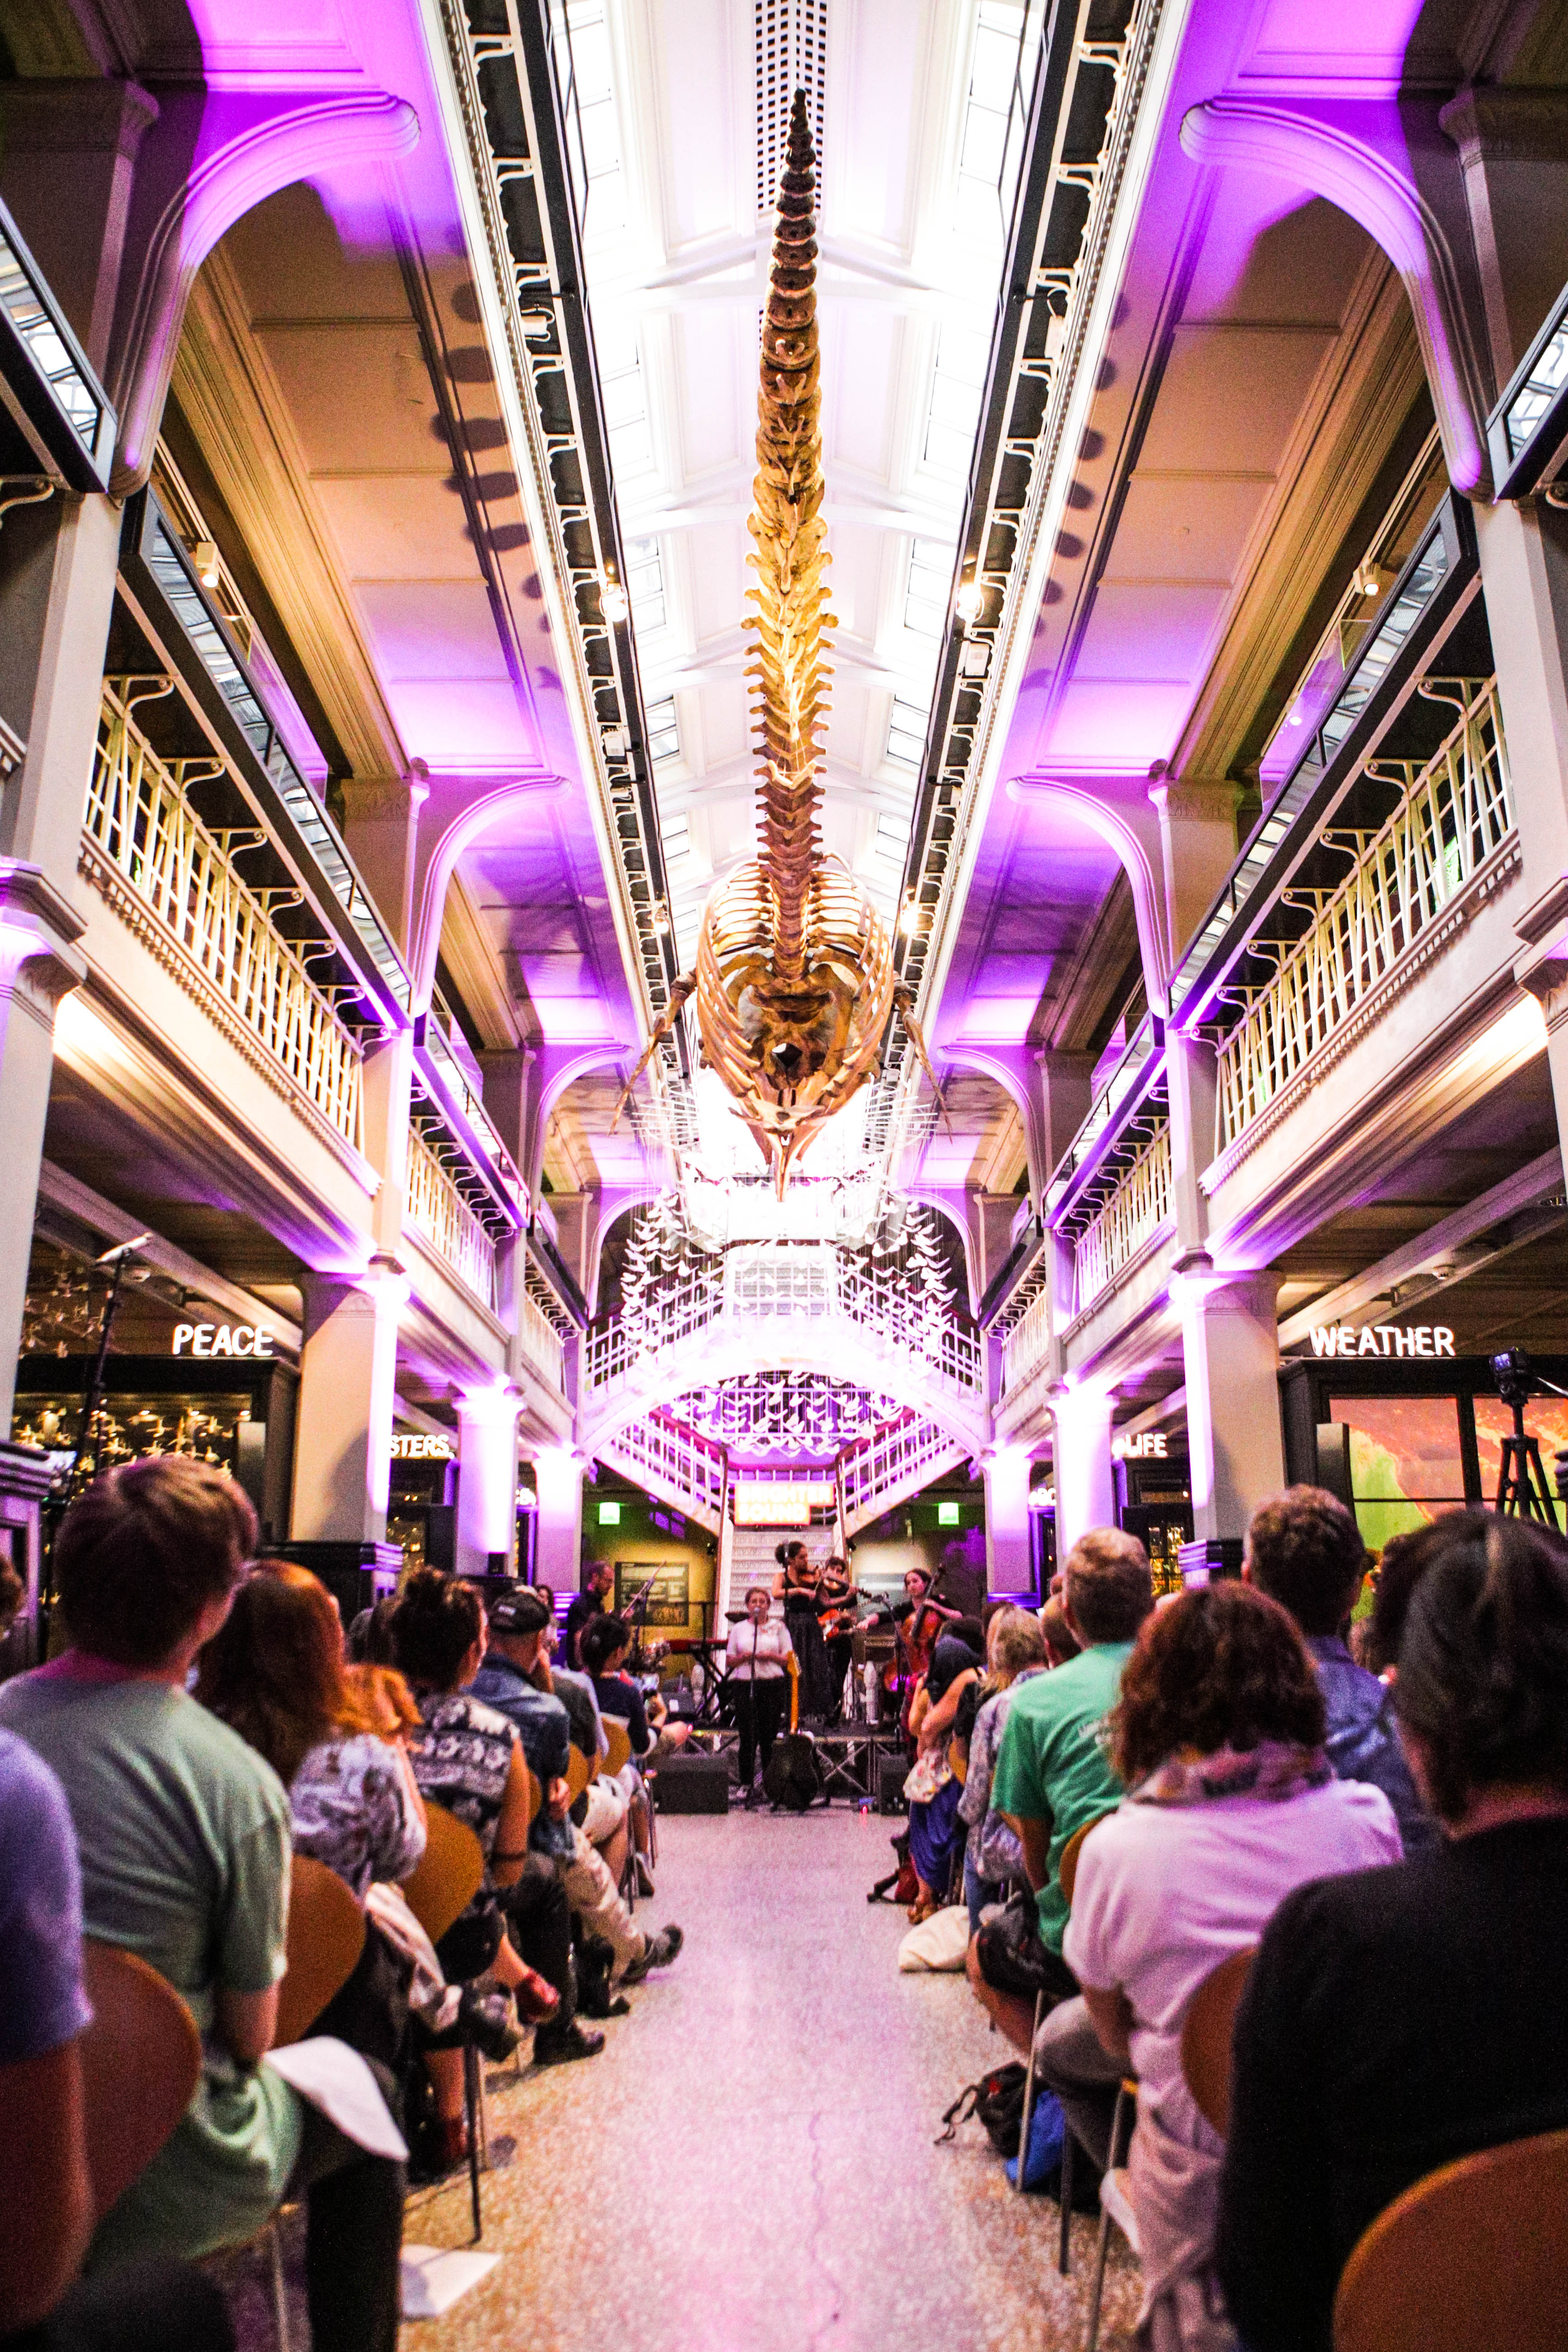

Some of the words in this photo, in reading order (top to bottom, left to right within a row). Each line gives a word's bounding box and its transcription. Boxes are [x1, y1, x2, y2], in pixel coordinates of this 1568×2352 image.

[172, 1324, 275, 1356] PEACE
[1308, 1326, 1456, 1356] WEATHER
[1125, 1433, 1167, 1456] LIFE
[738, 1485, 831, 1503] BRIGHTER
[738, 1503, 807, 1521] SOUND
